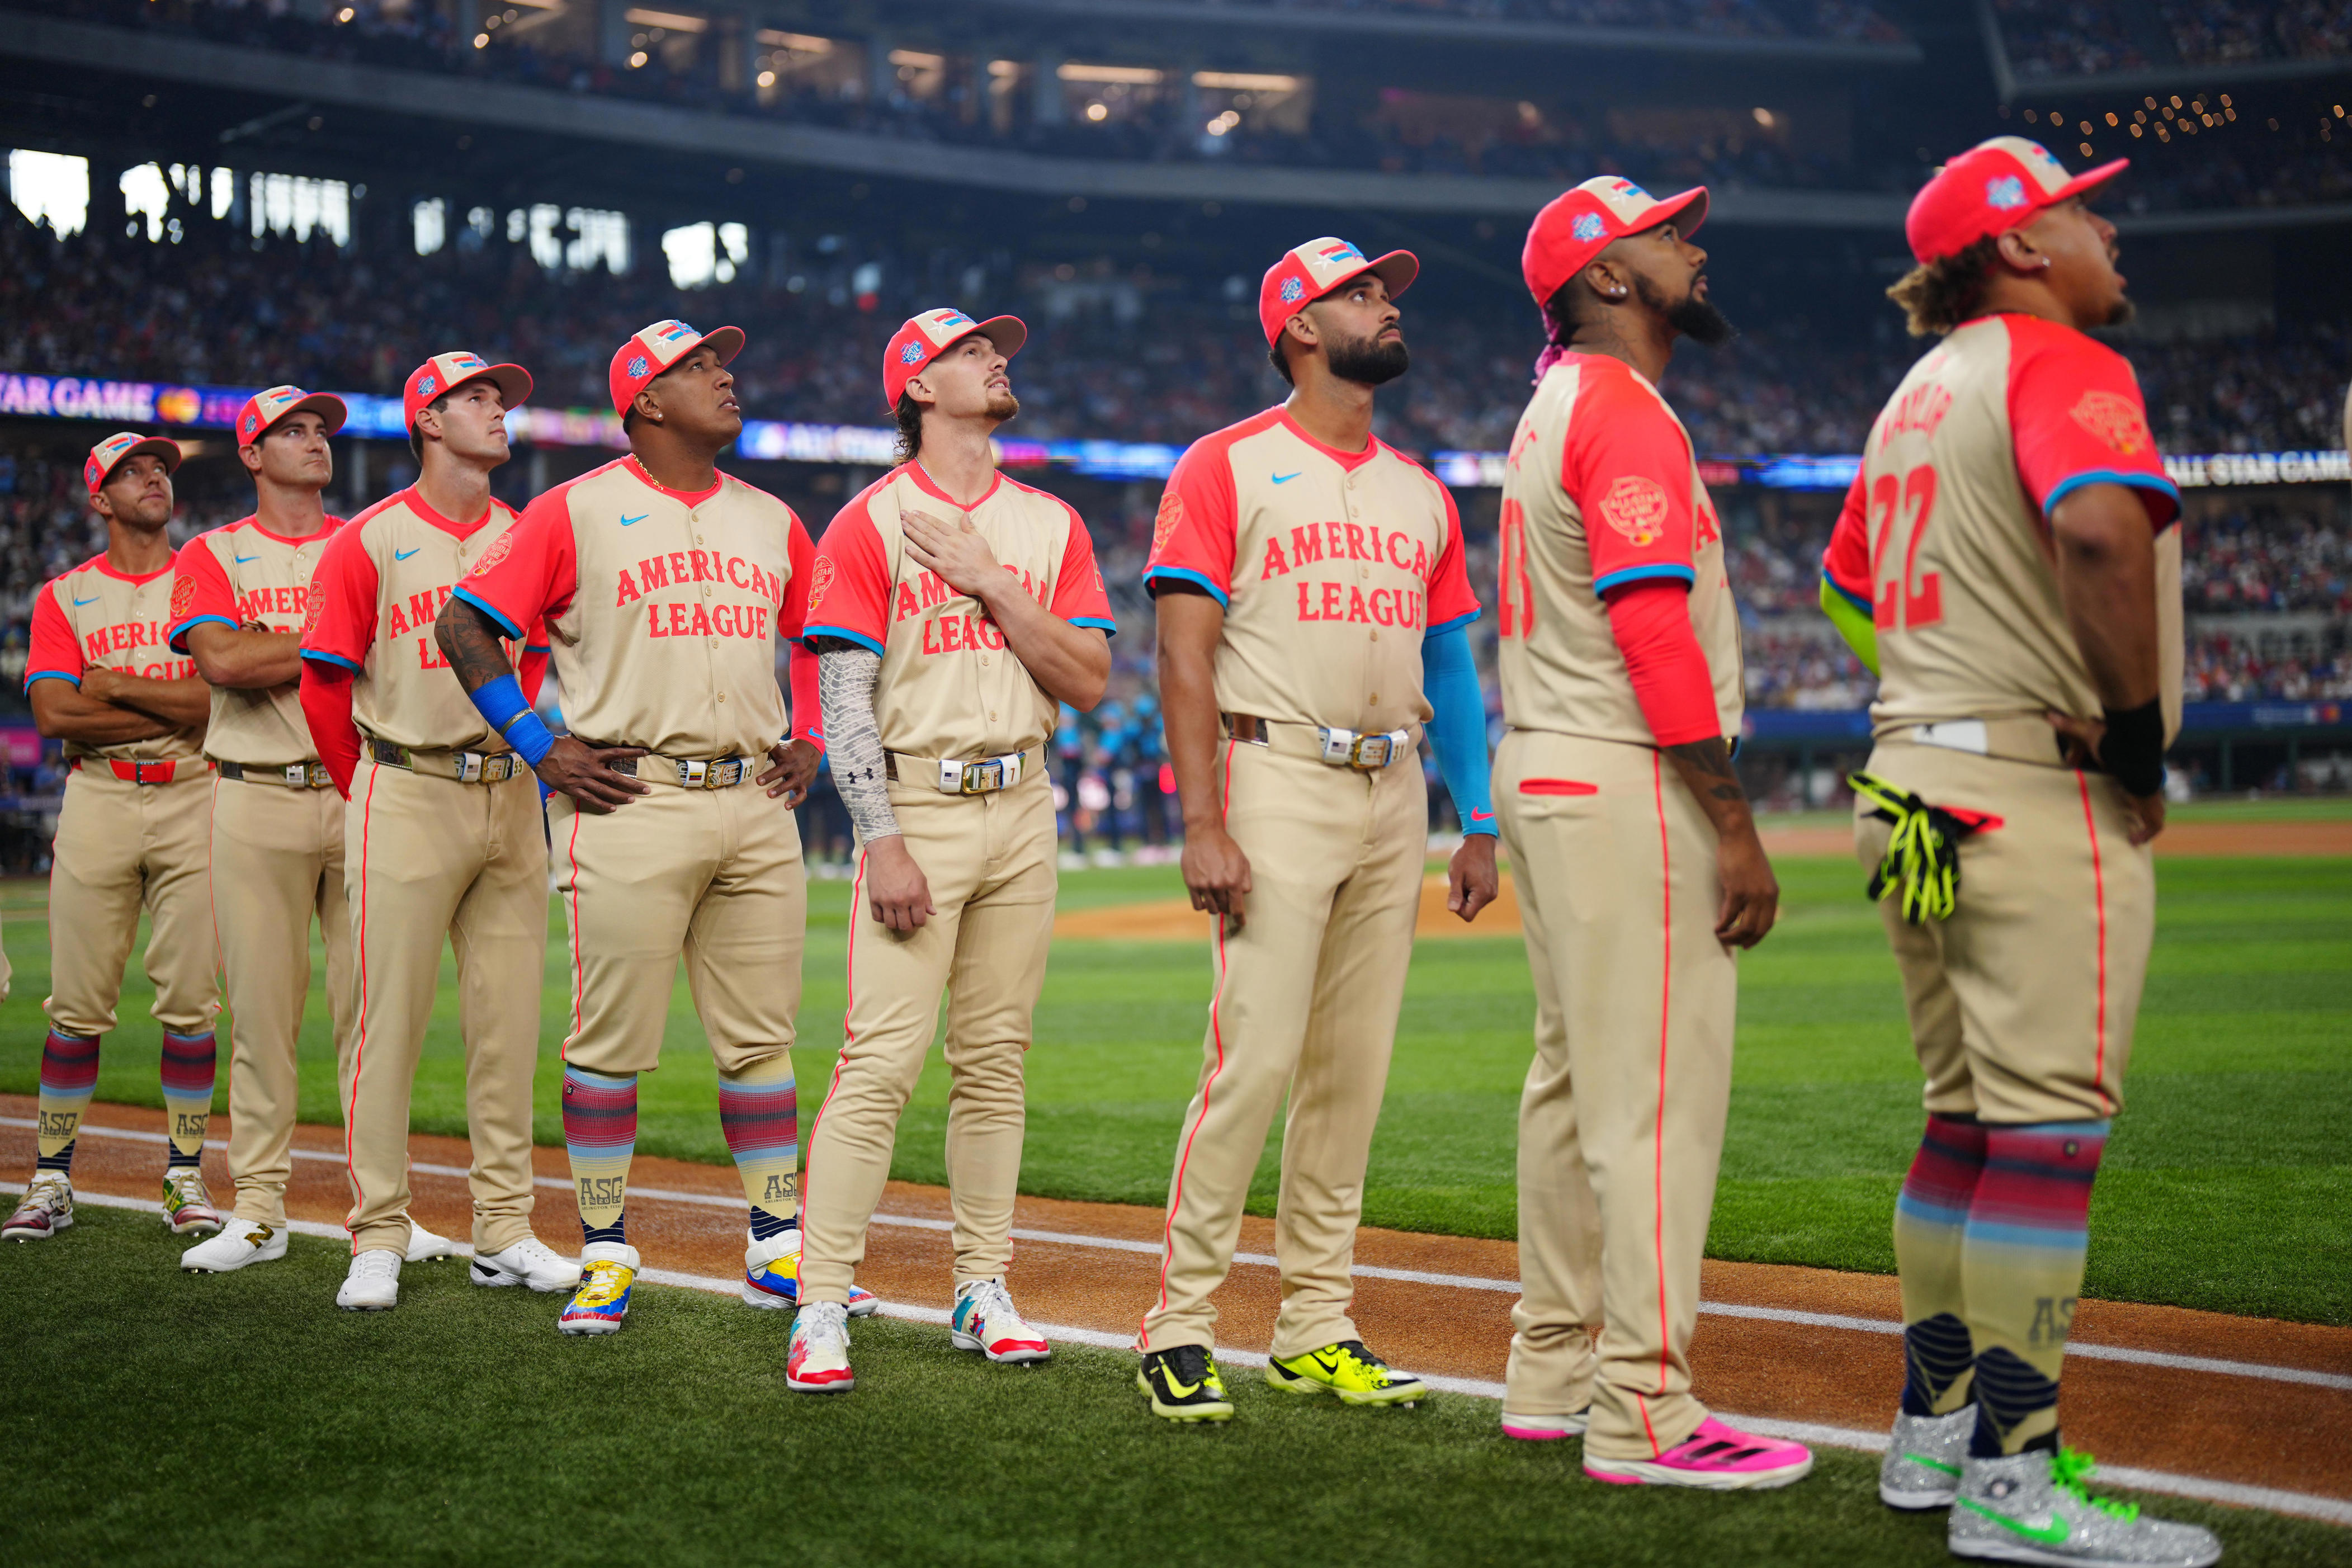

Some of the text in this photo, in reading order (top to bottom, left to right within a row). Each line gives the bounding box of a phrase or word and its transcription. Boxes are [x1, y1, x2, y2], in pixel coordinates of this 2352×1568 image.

[0, 374, 51, 415] AR
[52, 377, 154, 422] GAME
[2211, 453, 2280, 485] STAR
[1871, 464, 1943, 634] 22
[617, 549, 780, 610] AMERICAN
[649, 603, 767, 640] LEAGUE
[1297, 582, 1421, 632] LEAGUE
[923, 616, 1010, 655] LEAG
[514, 760, 523, 774] 55
[744, 764, 753, 778] 13
[39, 1110, 77, 1136] ASG
[580, 1176, 622, 1205] ASG
[764, 1172, 797, 1199] AS
